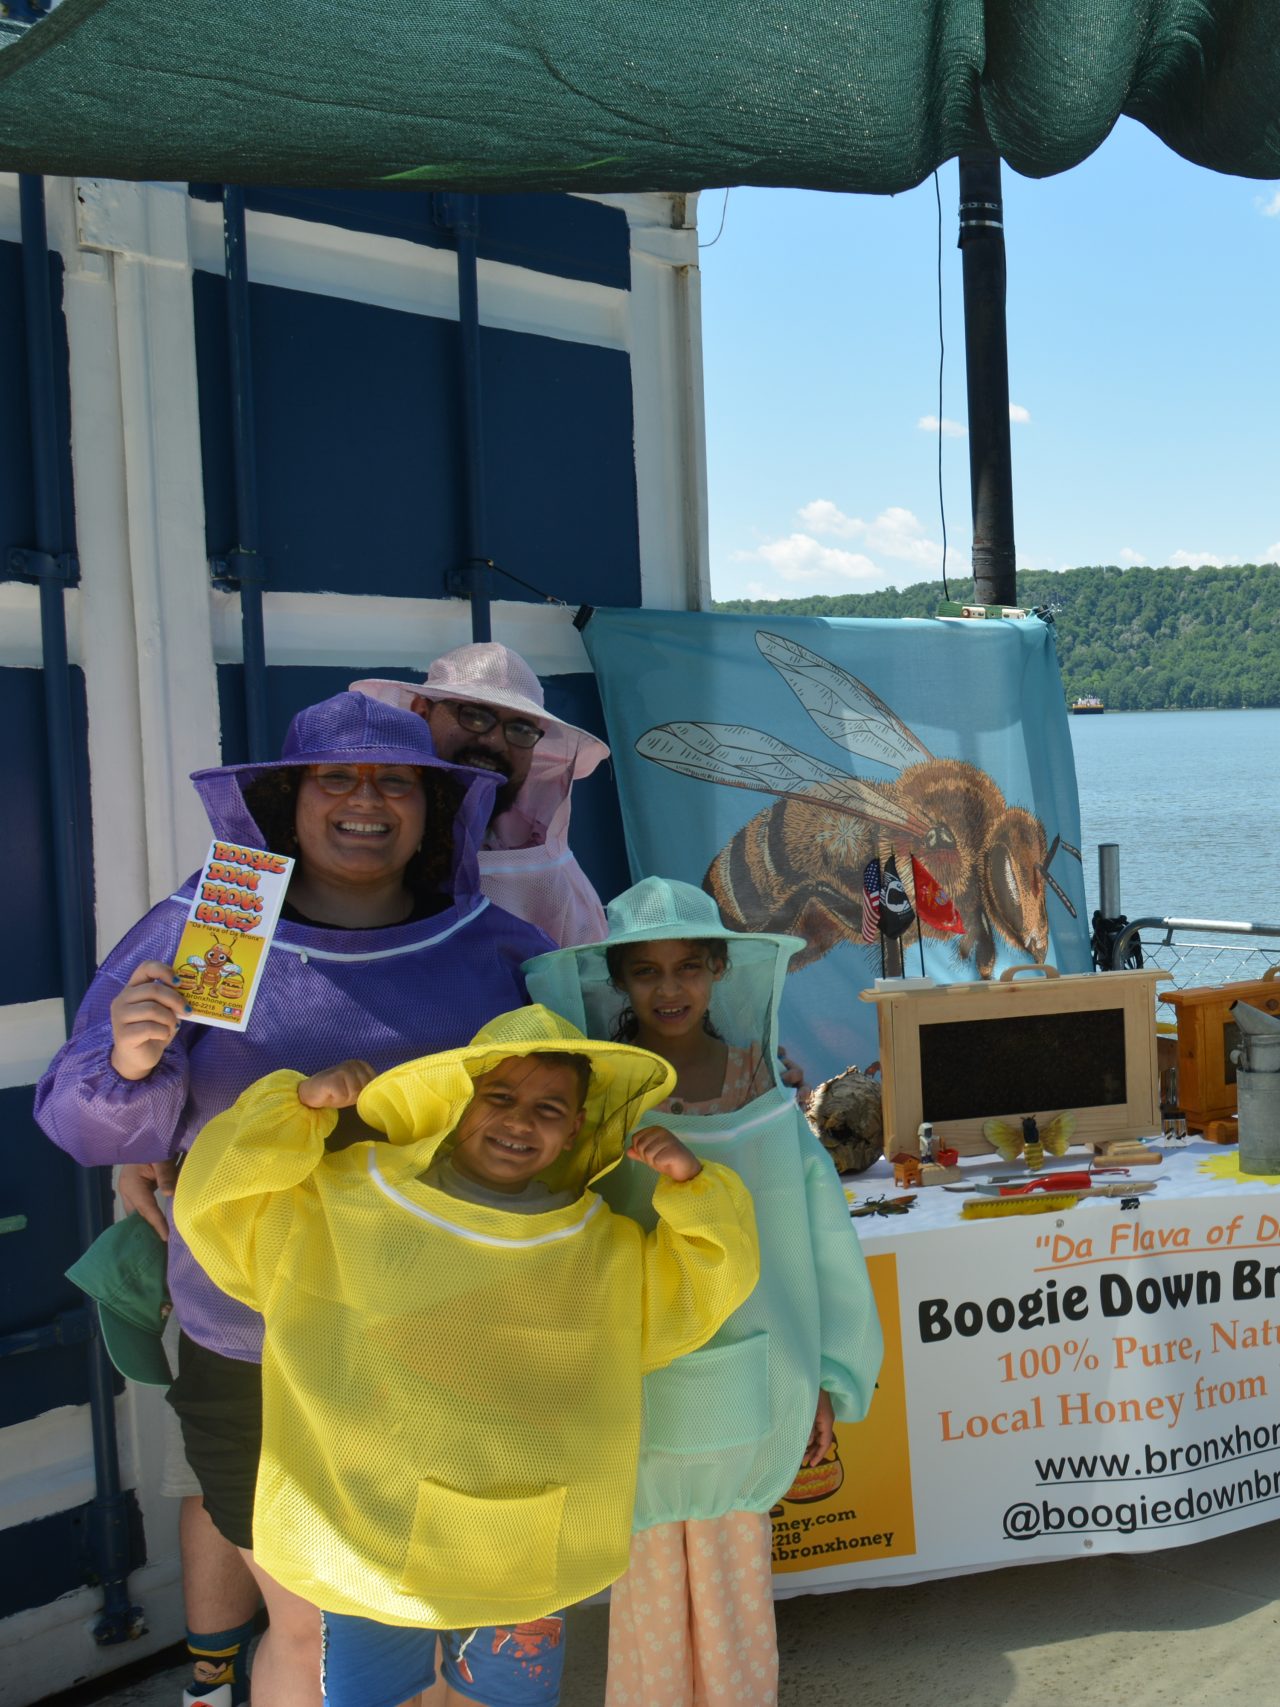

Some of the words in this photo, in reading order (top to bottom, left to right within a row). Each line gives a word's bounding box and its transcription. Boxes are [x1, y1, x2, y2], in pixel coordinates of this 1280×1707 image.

[213, 842, 289, 874] BOOGIE
[206, 862, 261, 891] DOWN
[201, 882, 264, 913] BRONX
[195, 902, 262, 932] HONEY
[1035, 1234, 1092, 1263] "Da
[1110, 1222, 1191, 1255] Flava
[1206, 1215, 1244, 1245] of
[918, 1279, 1089, 1343] Boogie
[1100, 1270, 1222, 1318] Down
[997, 1338, 1100, 1383] 100%
[1112, 1334, 1201, 1370] Pure,
[938, 1396, 1046, 1442] Local
[1056, 1391, 1185, 1429] Honey
[1194, 1375, 1268, 1411] from
[772, 1531, 802, 1548] 218
